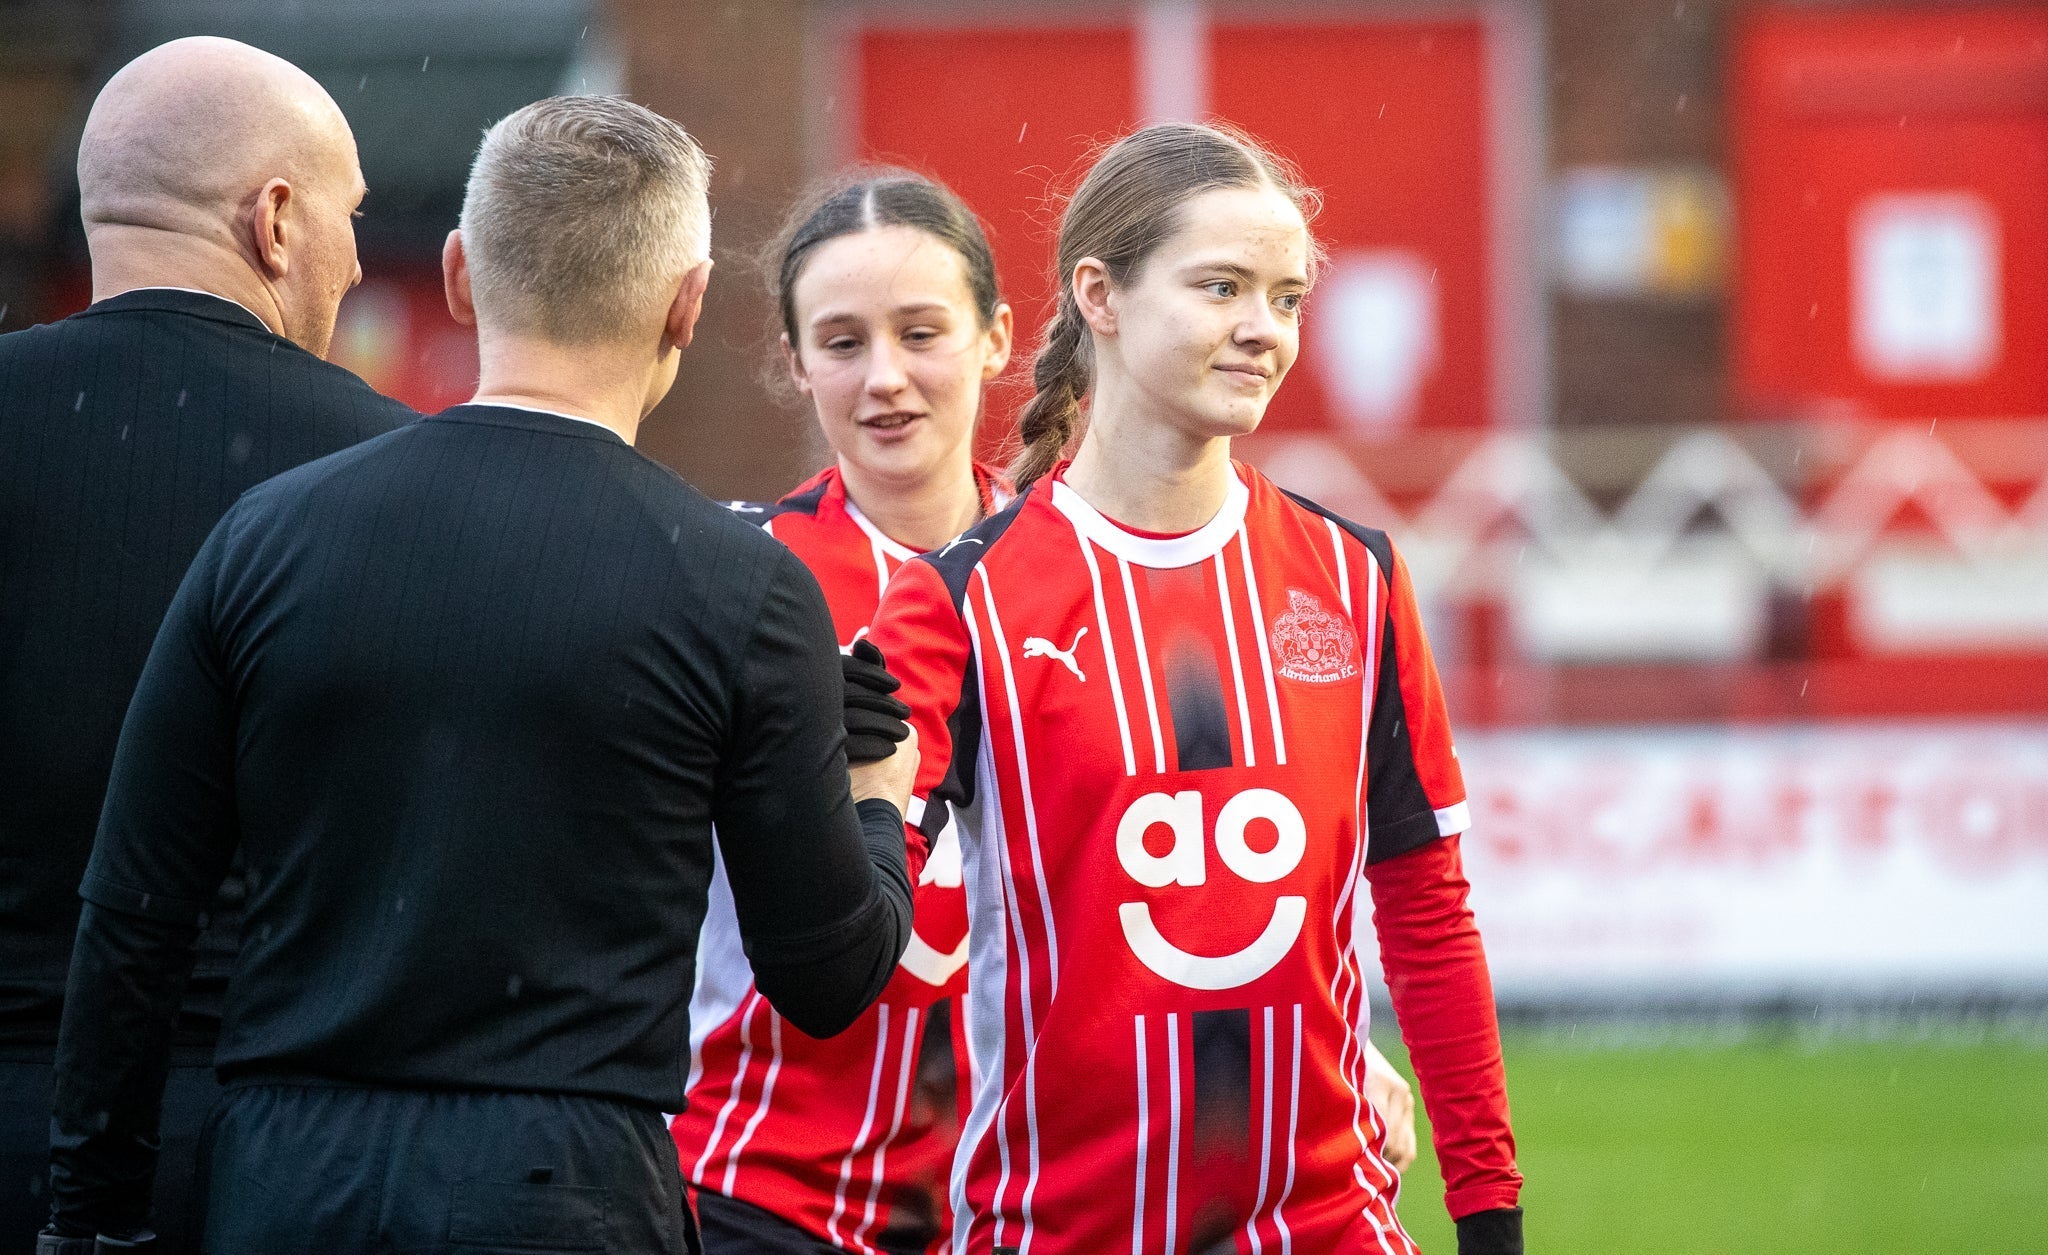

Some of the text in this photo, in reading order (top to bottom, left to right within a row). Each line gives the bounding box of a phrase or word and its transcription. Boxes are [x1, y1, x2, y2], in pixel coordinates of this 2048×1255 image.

[1278, 664, 1358, 683] Altrincham F.C.
[1115, 788, 1308, 888] ao
